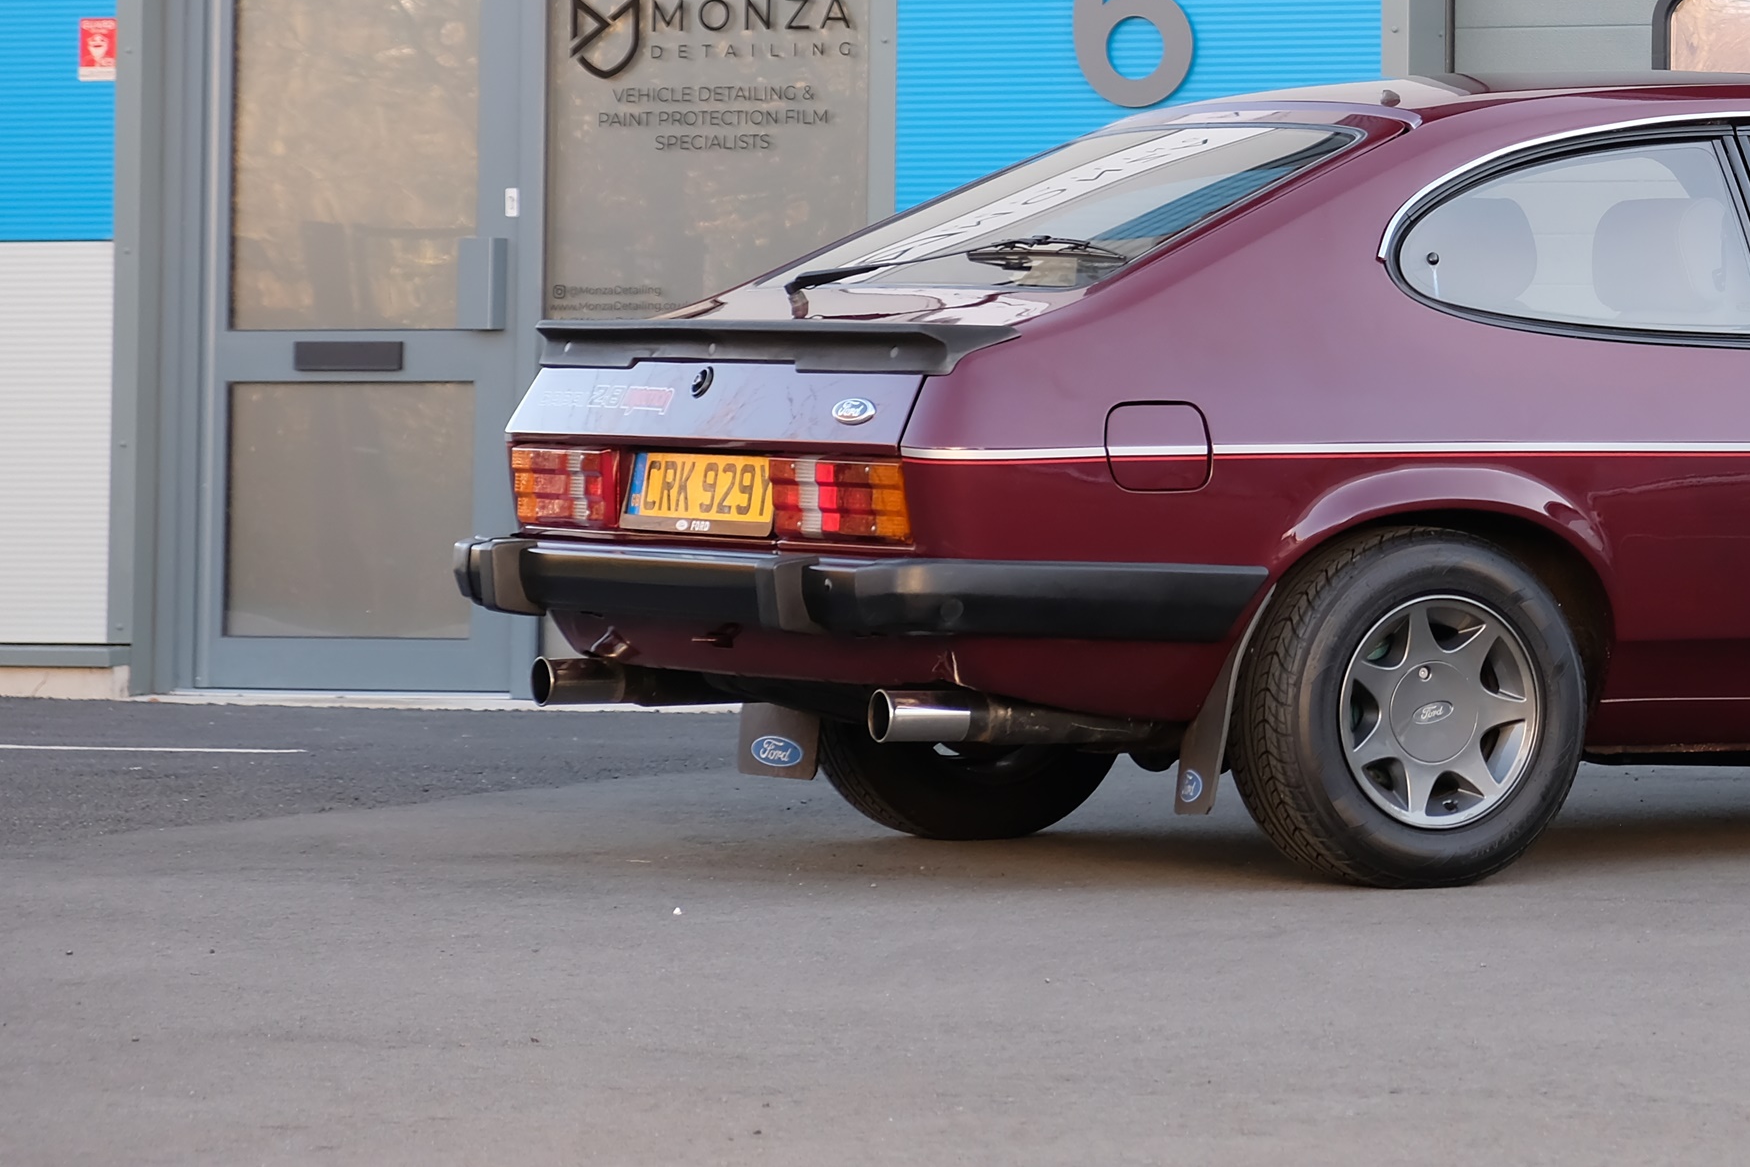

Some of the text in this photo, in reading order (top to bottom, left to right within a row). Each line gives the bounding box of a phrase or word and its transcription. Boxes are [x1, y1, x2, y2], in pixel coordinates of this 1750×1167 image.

[651, 42, 852, 59] DETAILING
[613, 85, 815, 103] VEHICLE DETAILING &
[599, 109, 829, 127] PAINT PROTECTION FILM
[655, 134, 771, 150] SPECIALISTS
[643, 460, 772, 517] CRK 929Y
[690, 520, 711, 532] FORD
[1420, 705, 1443, 720] Ford
[760, 739, 792, 762] Ford
